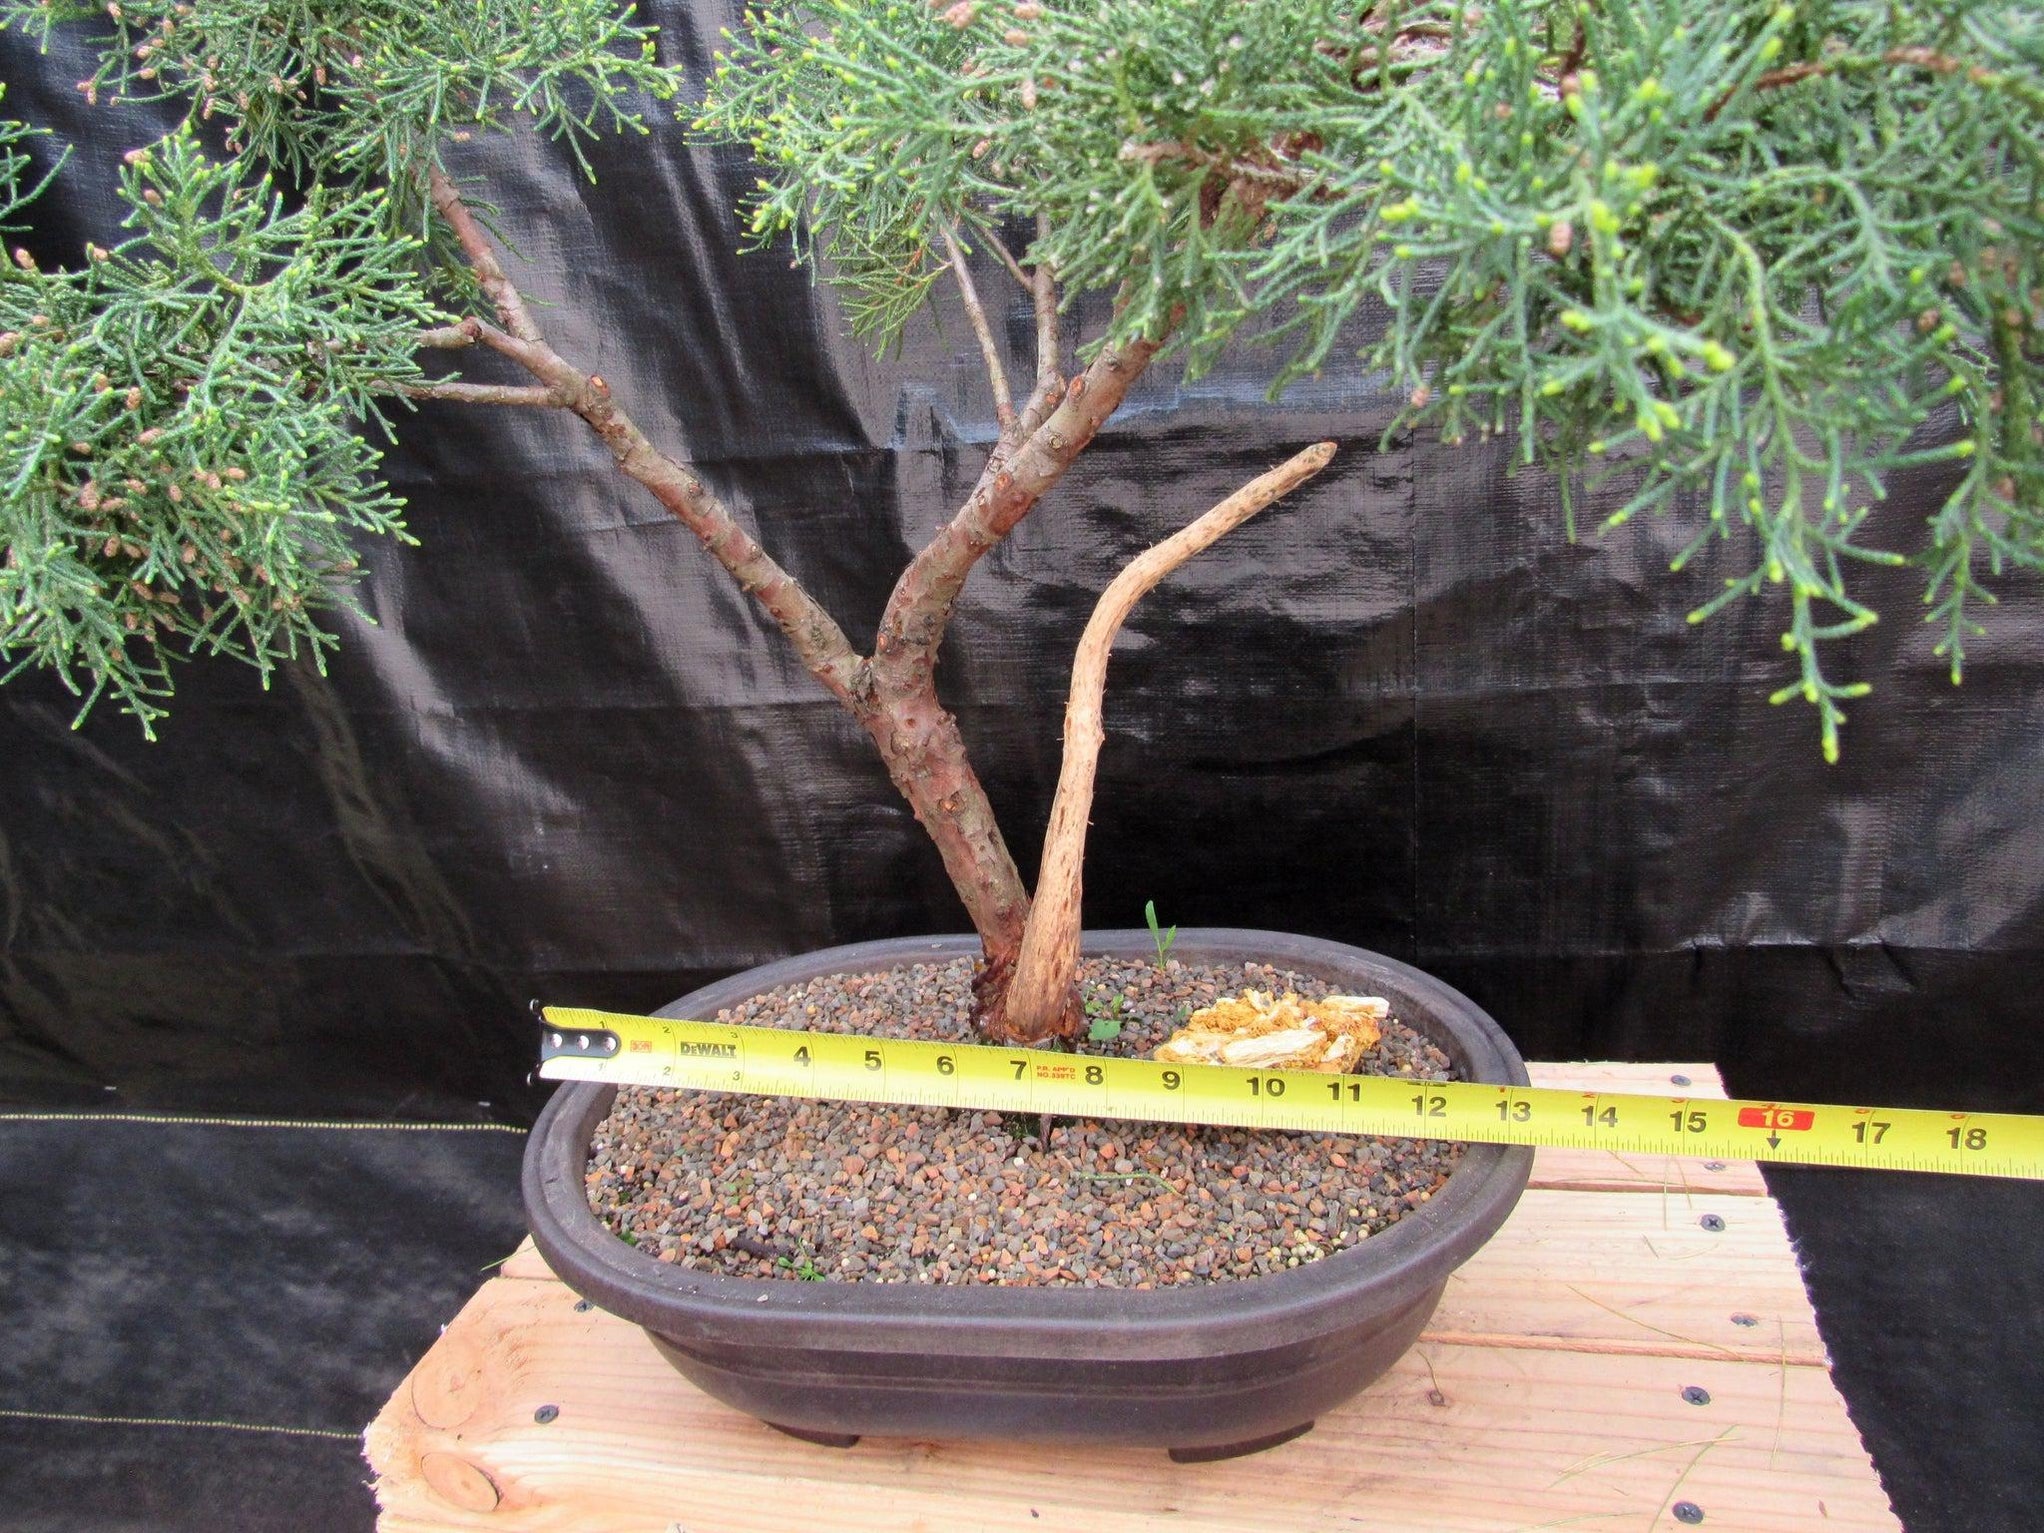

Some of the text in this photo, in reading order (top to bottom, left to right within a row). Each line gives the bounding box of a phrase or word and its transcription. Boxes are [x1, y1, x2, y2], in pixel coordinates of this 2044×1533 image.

[662, 1025, 672, 1034] 2
[730, 1031, 739, 1040] 3
[662, 1066, 672, 1077] 2
[732, 1071, 741, 1081] 3
[793, 1046, 1987, 1151] 4 5 6 7 8 9 10 11 12 13 14 15 16 17 18
